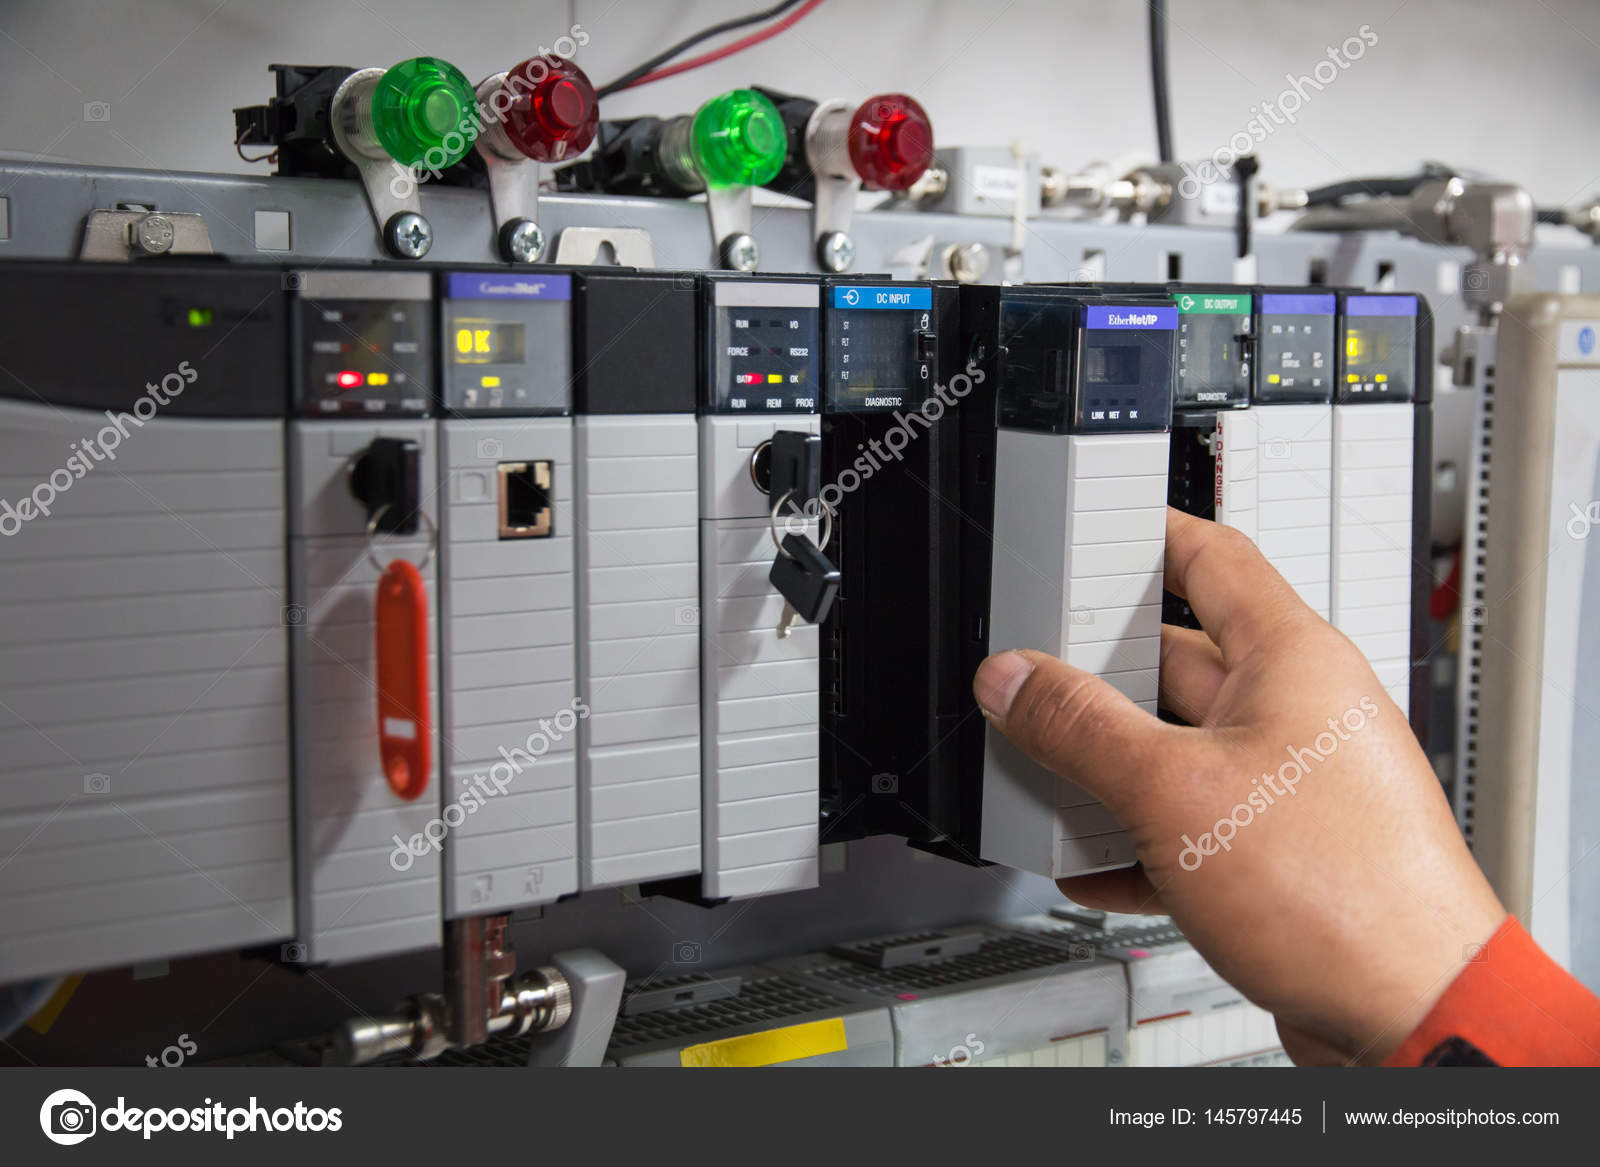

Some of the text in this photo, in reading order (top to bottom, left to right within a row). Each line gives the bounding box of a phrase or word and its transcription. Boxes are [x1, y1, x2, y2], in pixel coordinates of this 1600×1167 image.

[876, 293, 911, 304] DC INPUT
[735, 319, 749, 329] RUN
[1108, 314, 1158, 326] EtherNet/IP
[456, 329, 491, 353] OK
[727, 347, 749, 356] FORCE
[789, 348, 808, 356] RS232
[789, 375, 798, 383] OK
[731, 398, 814, 408] RUN REM PROG
[865, 397, 902, 407] DIAGNOSTIC
[1091, 410, 1138, 420] LINK NET OK
